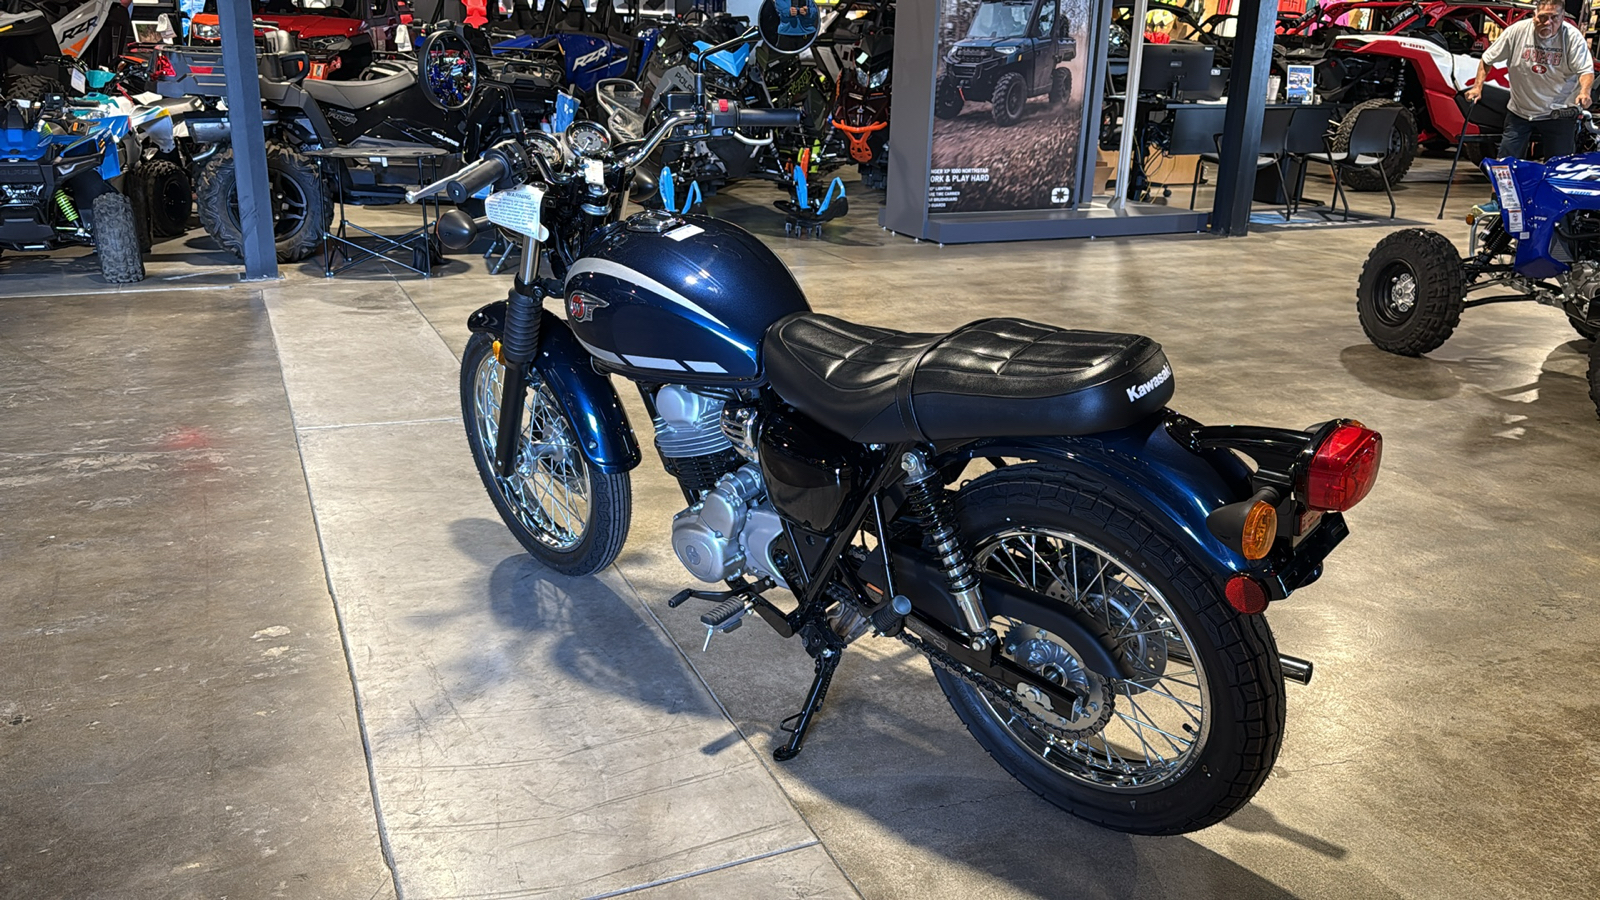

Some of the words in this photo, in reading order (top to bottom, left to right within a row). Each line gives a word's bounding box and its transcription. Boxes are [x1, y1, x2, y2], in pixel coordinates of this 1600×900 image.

[59, 15, 99, 45] RZR
[572, 46, 608, 72] RZR
[431, 131, 460, 147] POLARIS
[930, 175, 944, 183] ORK
[952, 174, 970, 182] PLAY
[970, 174, 990, 182] HARD
[506, 191, 531, 200] WARNING
[1126, 361, 1171, 402] Kawasaki
